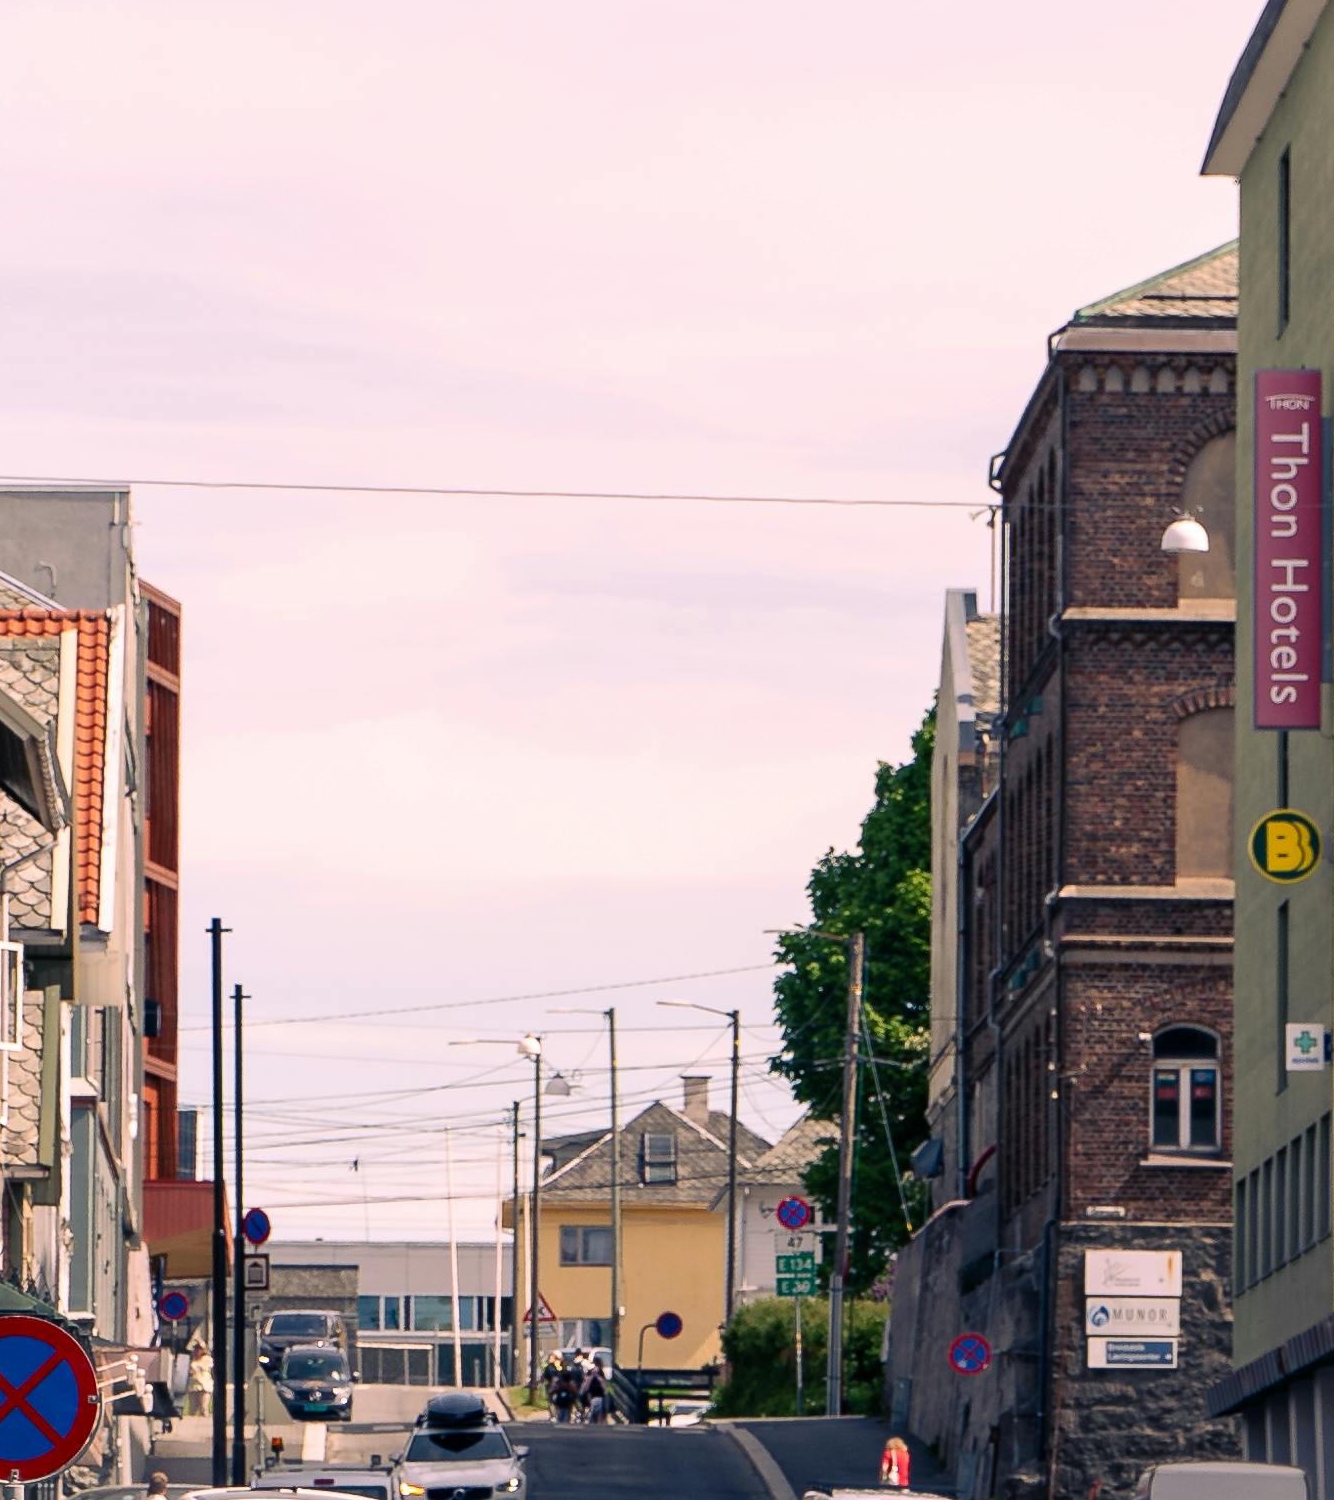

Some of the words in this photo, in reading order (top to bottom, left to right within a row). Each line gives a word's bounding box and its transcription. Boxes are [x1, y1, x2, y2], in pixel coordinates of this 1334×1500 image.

[1270, 397, 1309, 410] THON
[1270, 422, 1310, 539] Thon
[1270, 558, 1310, 704] Hotels
[1112, 1307, 1168, 1322] MUNOR
